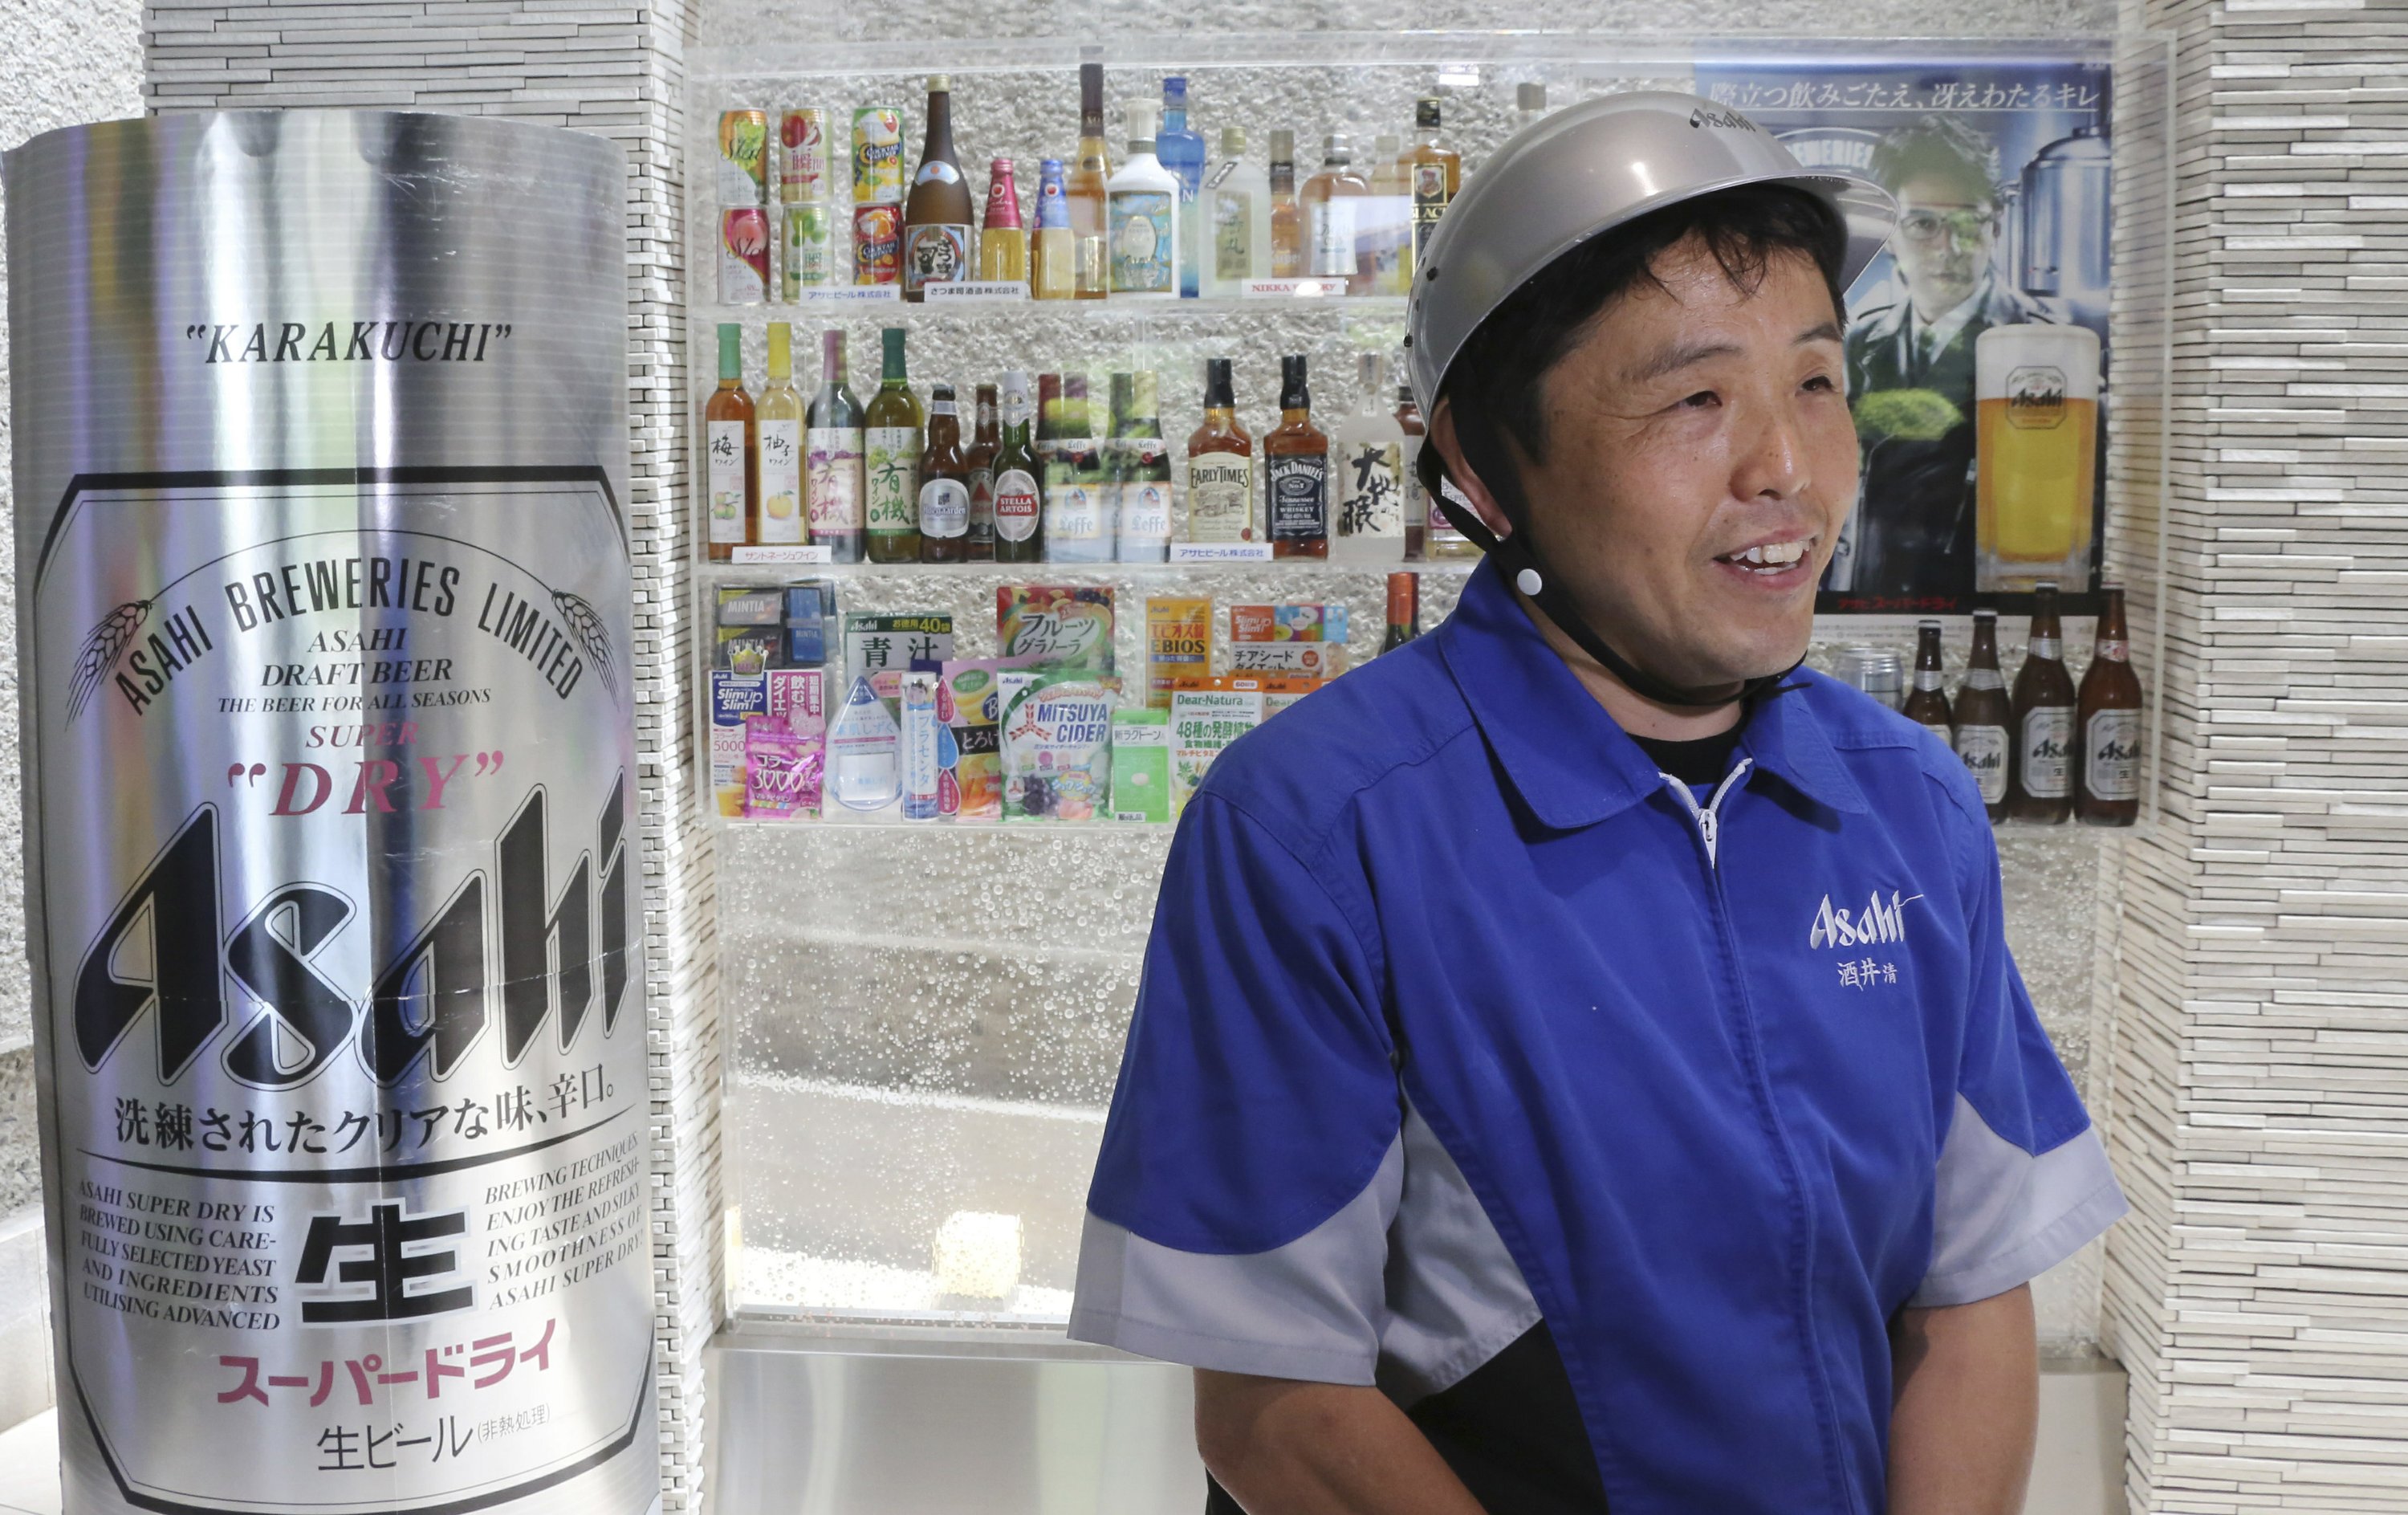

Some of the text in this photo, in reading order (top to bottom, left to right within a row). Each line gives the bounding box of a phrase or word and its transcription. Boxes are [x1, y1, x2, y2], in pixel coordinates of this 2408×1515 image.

[1690, 108, 1756, 132] Asahi
[1252, 283, 1291, 292] NIKKA
[1270, 463, 1291, 482] JACK
[1000, 496, 1032, 505] STELLA
[1000, 505, 1033, 514] ARTOIS
[745, 551, 820, 561] サントネージュワイン
[1180, 549, 1264, 558] アサヒビール株式会社
[727, 601, 765, 613] MINTIA
[115, 556, 586, 716] ASAHI BREWERIES LIMITED
[850, 619, 878, 631] Asahi
[1021, 614, 1096, 637] フルーツ
[307, 628, 409, 653] ASAHI
[1017, 638, 1082, 655] グラノーラ
[1151, 640, 1206, 654] EBIOS
[1235, 650, 1295, 663] チアシード
[260, 658, 454, 686] DRAFT BEER
[218, 688, 491, 713] THE BEER FOR ALL SEASONS
[718, 689, 744, 700] Slim
[1177, 694, 1243, 707] Dear-Natura
[1037, 703, 1108, 723] MITSUYA
[306, 722, 420, 748] SUPER
[1056, 724, 1107, 743] CIDER
[73, 767, 628, 1089] Asahi
[1810, 890, 1906, 950] Asahi
[115, 1062, 616, 1155] 洗練されたクリアな味、辛口。
[485, 1131, 639, 1205] BREWING TECHNIQUES
[80, 1180, 275, 1223] ASAHI SUPER DRY IS
[486, 1156, 640, 1232] ENJOY THE REFRESH-
[80, 1204, 276, 1250] BREWED USING CARE-
[487, 1182, 641, 1258] ING TASTE AND SILKY
[81, 1230, 277, 1277] FULLY SELECTED YEAST
[487, 1204, 642, 1285] SMOOTHNESS OF
[295, 1202, 475, 1325] 生
[83, 1258, 279, 1304] AND INGREDIENTS
[490, 1275, 556, 1310] ASAHI
[563, 1249, 615, 1288] SUPER
[83, 1281, 281, 1330] UTILISING ADVANCED
[217, 1318, 556, 1408] スーパードライ
[317, 1403, 551, 1472] 生ビール (非熱処理)
